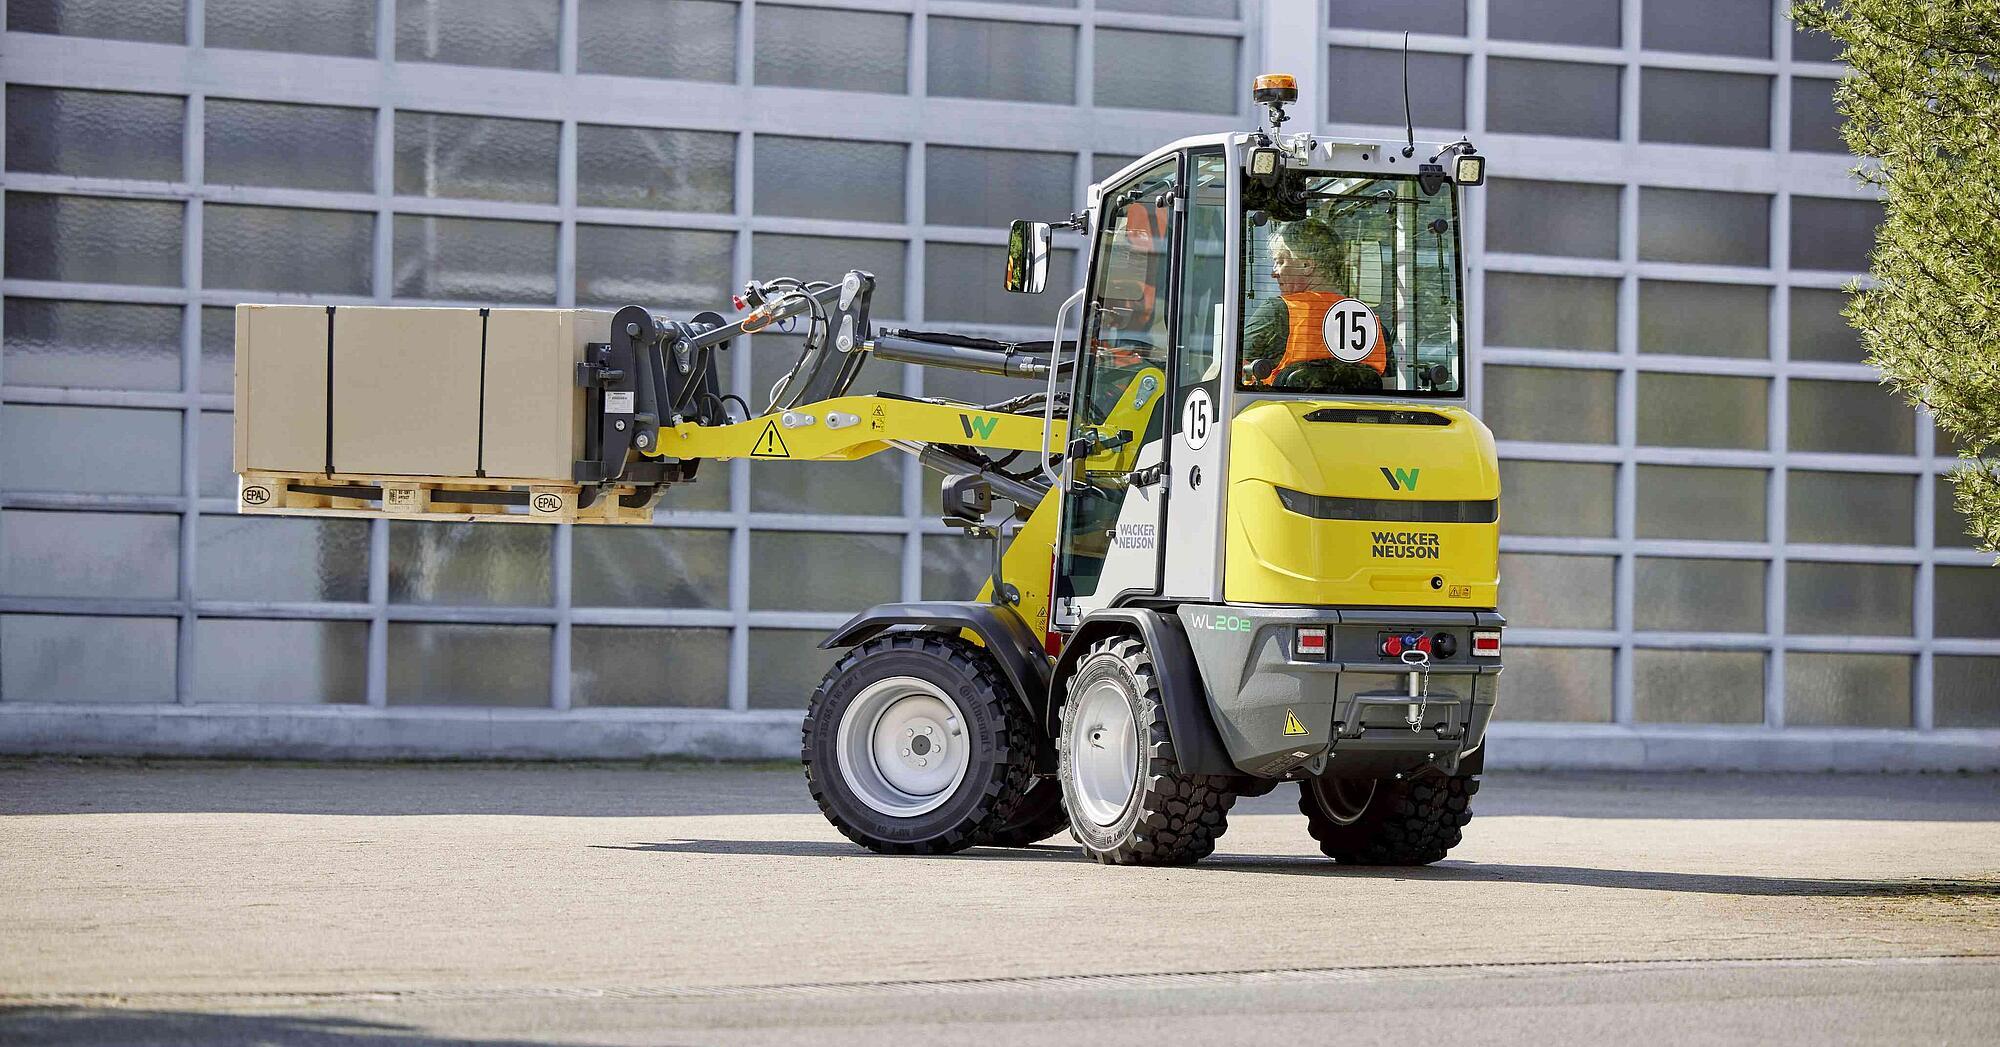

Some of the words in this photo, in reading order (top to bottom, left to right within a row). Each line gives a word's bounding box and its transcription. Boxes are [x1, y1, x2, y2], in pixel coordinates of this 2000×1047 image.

[1334, 310, 1367, 351] 15
[1188, 399, 1207, 440] 15
[246, 489, 267, 501] EPAL
[538, 497, 559, 509] EPAL
[1119, 523, 1155, 537] WACKER
[1119, 536, 1155, 549] NEUSON
[1371, 531, 1440, 546] WACKER
[1372, 545, 1440, 559] NEUSON
[960, 685, 991, 744] Continental
